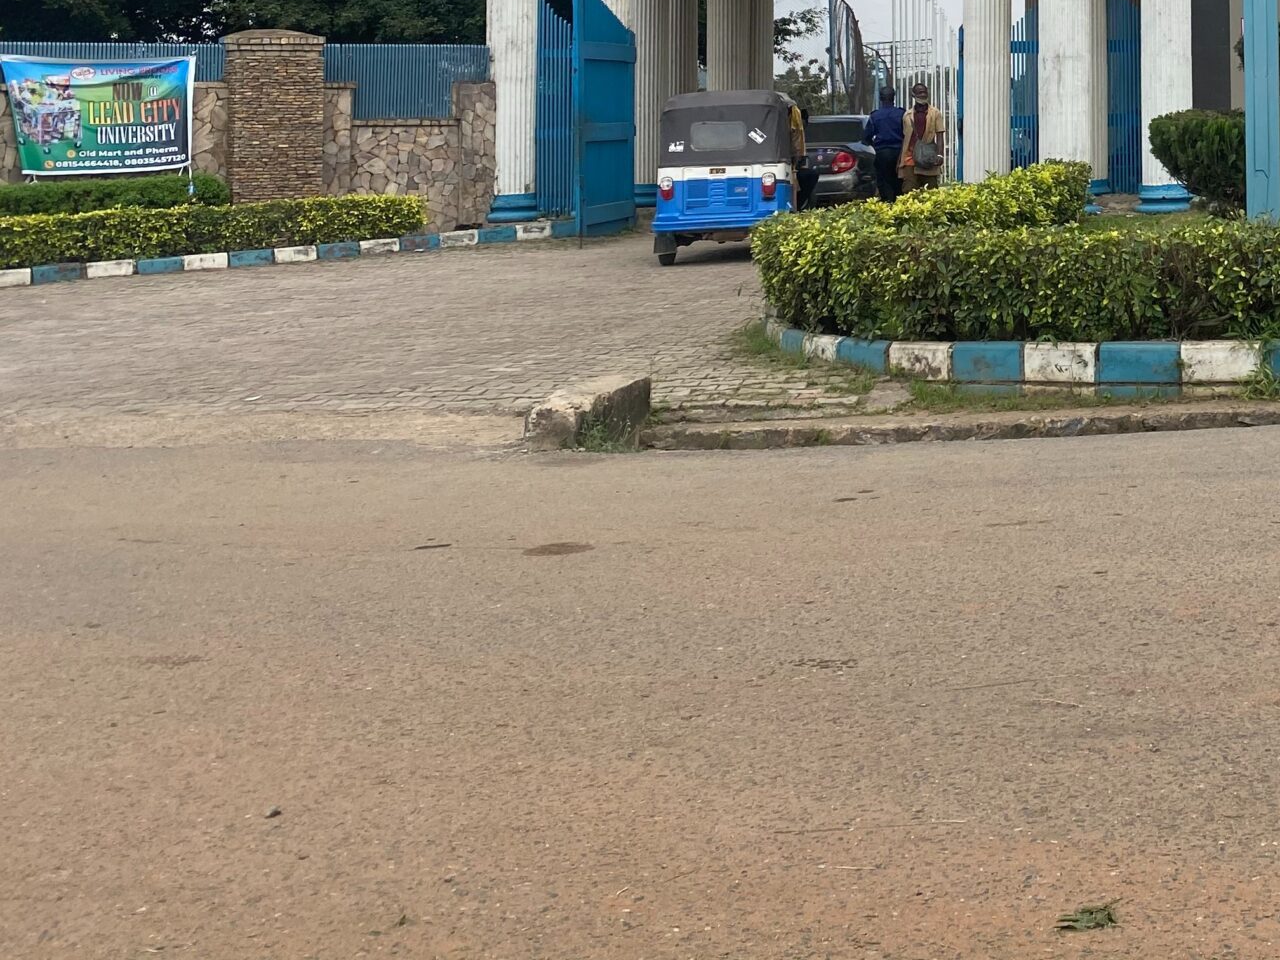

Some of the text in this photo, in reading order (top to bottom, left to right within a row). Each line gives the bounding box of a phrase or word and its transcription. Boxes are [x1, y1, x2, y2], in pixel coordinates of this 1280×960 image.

[100, 67, 135, 76] LIVING
[113, 82, 143, 101] NOW
[88, 97, 181, 125] LEAD CITY
[97, 123, 176, 145] UNIVERSITY
[79, 150, 96, 158] Old
[99, 149, 122, 157] Mart
[124, 148, 143, 156] and
